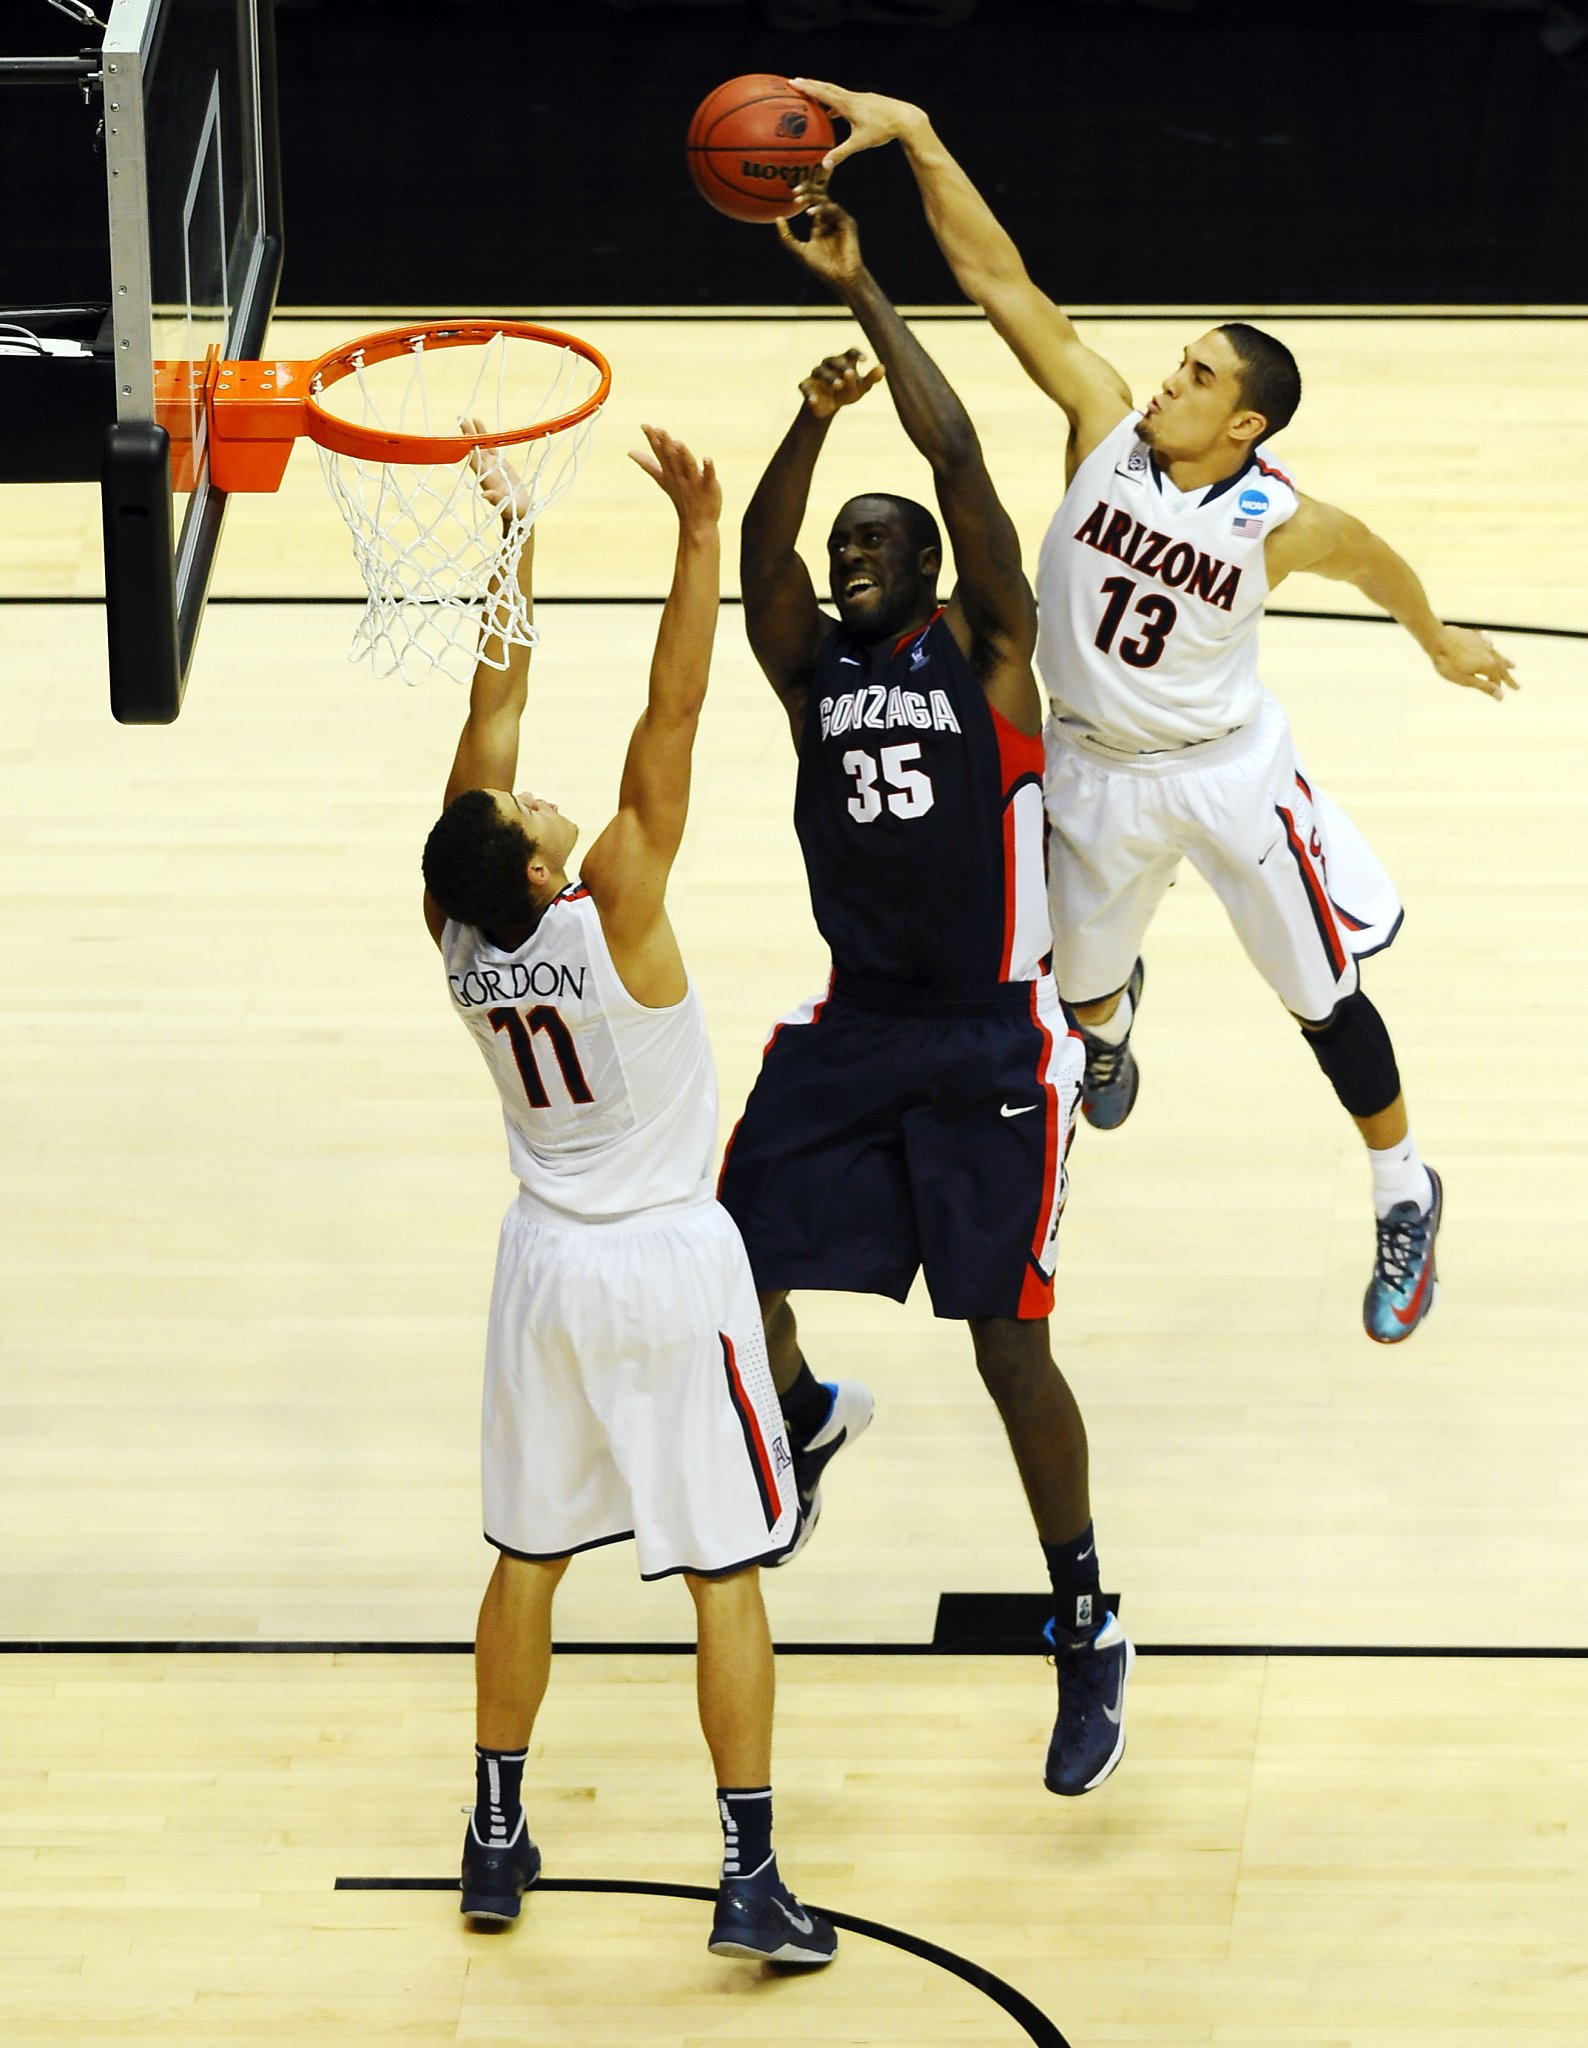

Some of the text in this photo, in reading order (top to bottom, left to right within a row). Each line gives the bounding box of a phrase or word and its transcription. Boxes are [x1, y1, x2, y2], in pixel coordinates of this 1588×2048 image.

[1073, 500, 1243, 612] ARIZONA
[1094, 576, 1178, 669] 13
[819, 685, 962, 741] GONZAGA
[842, 742, 935, 824] 35
[449, 961, 587, 1008] GORDON
[487, 1005, 596, 1109] 11
